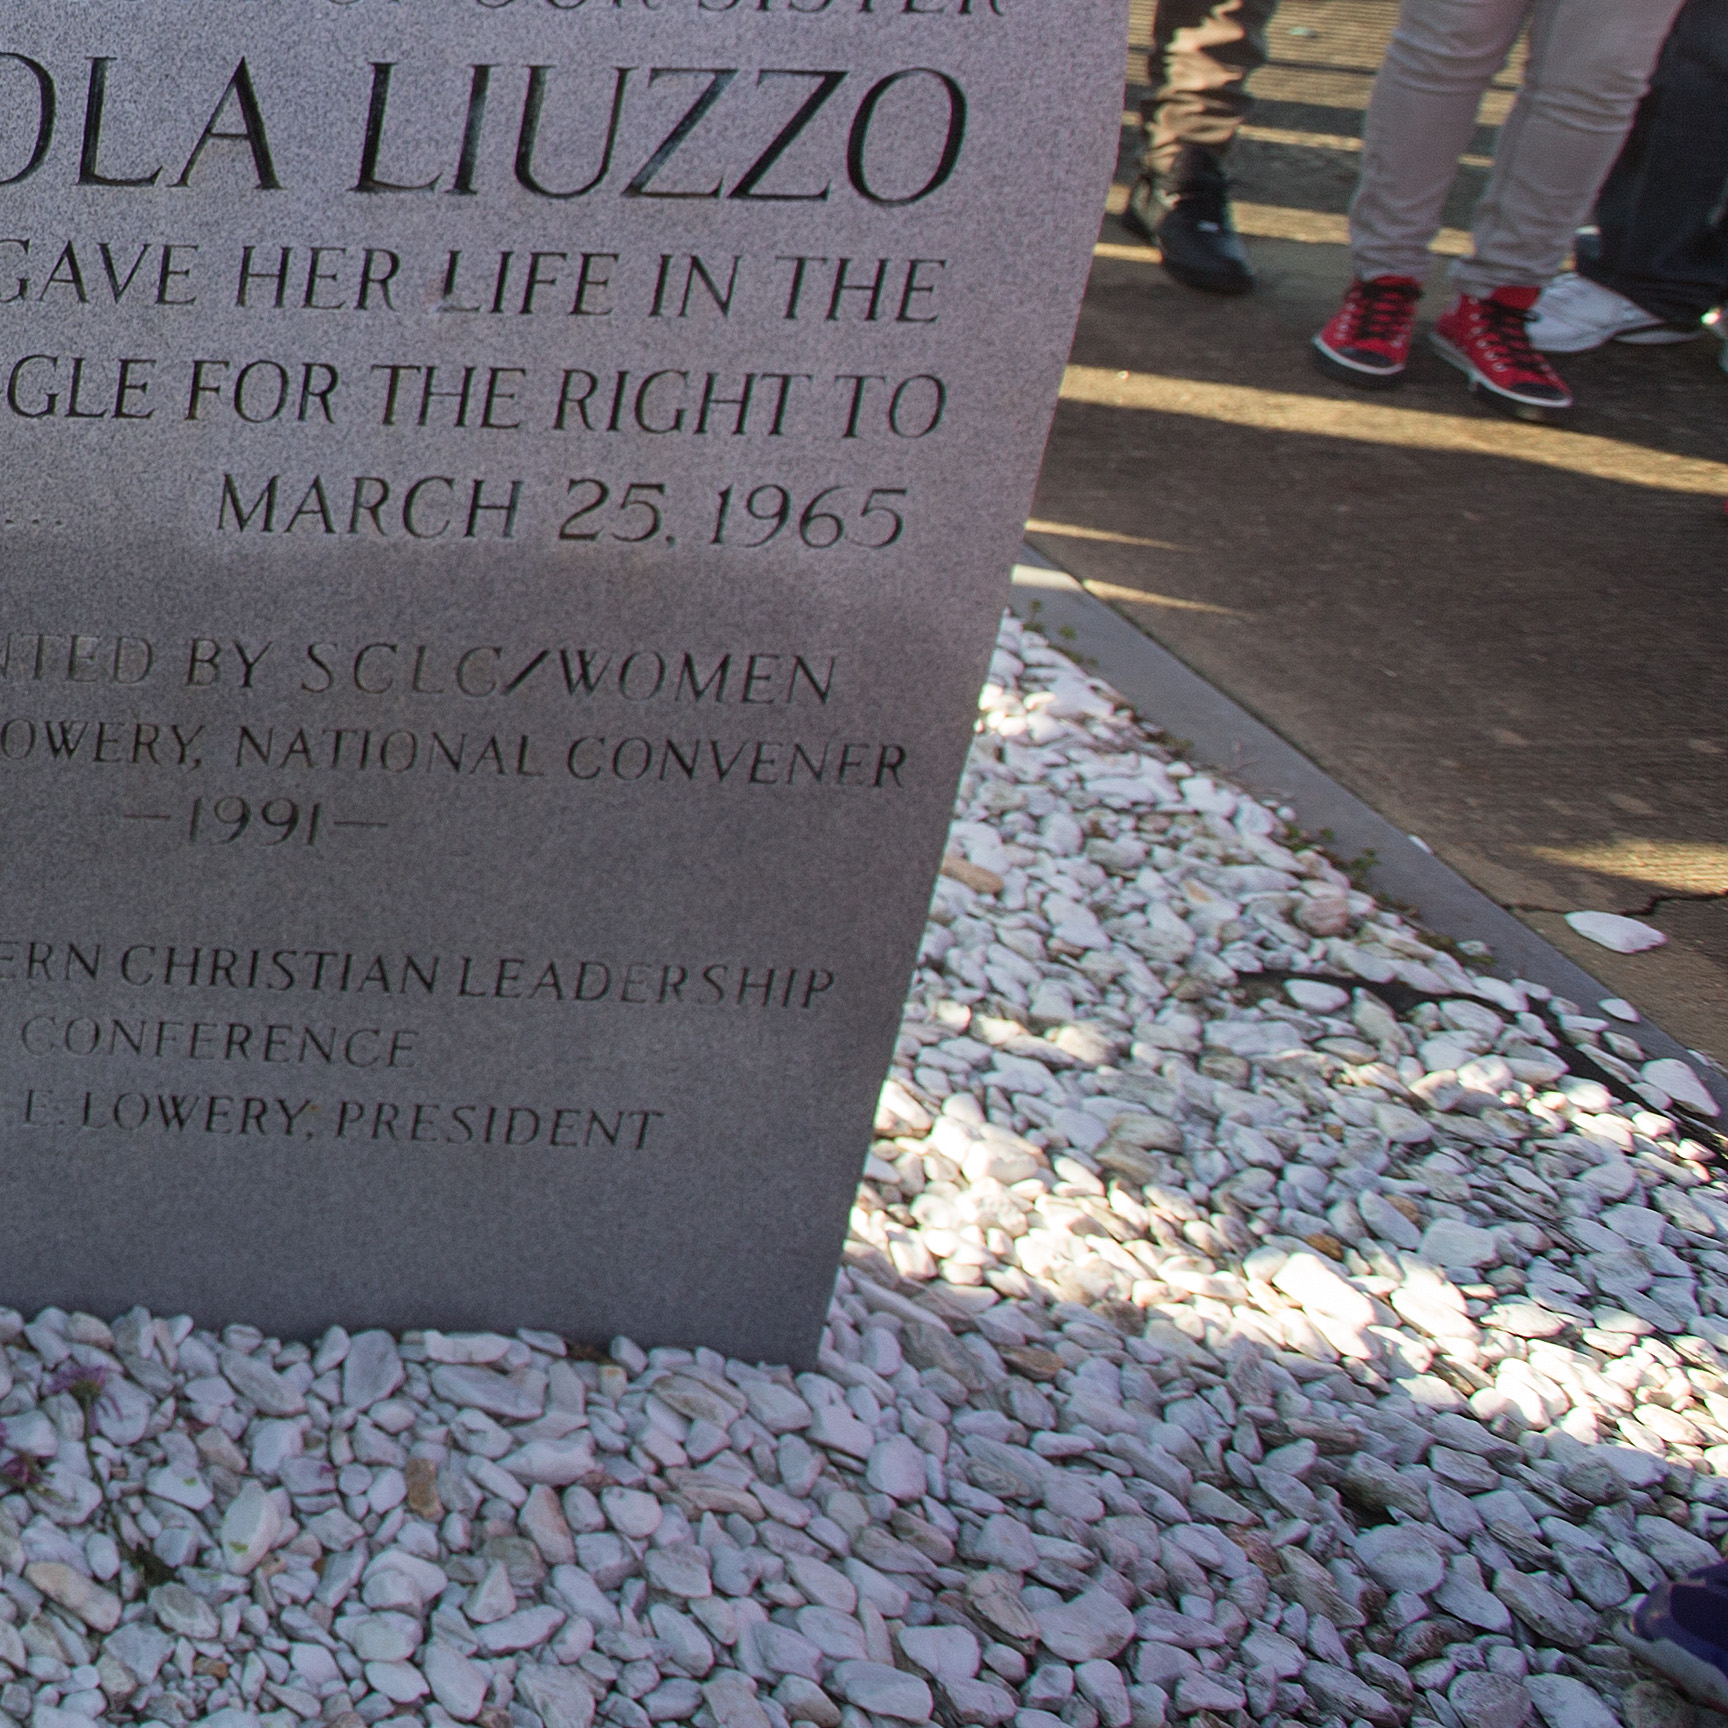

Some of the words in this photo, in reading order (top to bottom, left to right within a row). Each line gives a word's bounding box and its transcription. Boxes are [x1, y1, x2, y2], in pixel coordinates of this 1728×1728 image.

[345, 61, 968, 208] LIUZZO
[235, 243, 401, 312] HER
[433, 248, 620, 318] LIFE
[647, 252, 742, 319] IN
[773, 255, 947, 323] THE
[183, 358, 340, 425] FOR
[370, 362, 528, 430] THE
[552, 367, 813, 437] RIGHT
[834, 373, 947, 440] TO
[216, 472, 525, 539] MARCH
[709, 483, 909, 550] 1965
[184, 637, 274, 689] BY
[299, 641, 838, 706] SCLC/WOMEN
[234, 724, 545, 778] NATIONAL
[566, 734, 908, 789] CONVENER
[120, 943, 439, 996] CHRISTIAN
[456, 955, 837, 1011] LEADERSHIP
[20, 1015, 420, 1071] CONFERENCE
[335, 1101, 665, 1152] PRESIDENT
